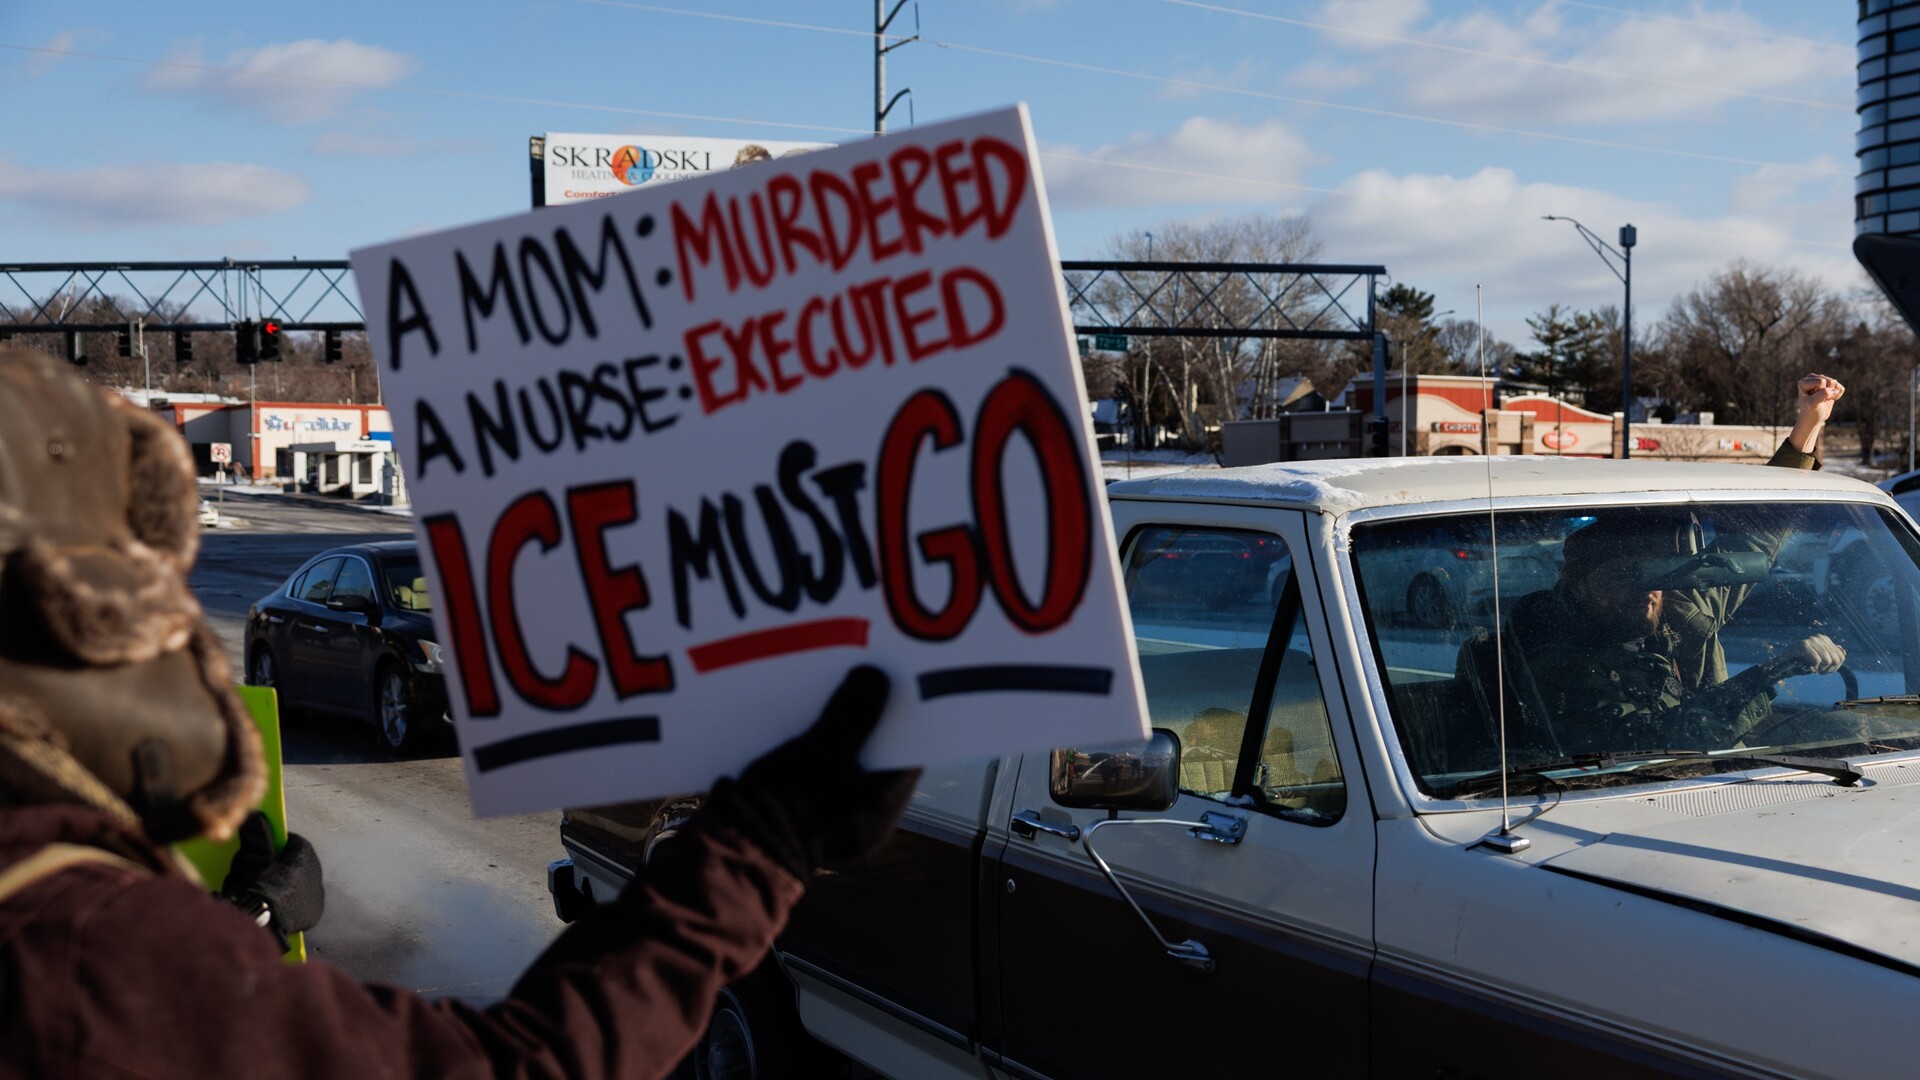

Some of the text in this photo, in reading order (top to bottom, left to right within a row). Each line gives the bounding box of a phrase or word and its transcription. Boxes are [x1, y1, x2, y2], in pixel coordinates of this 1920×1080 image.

[552, 145, 712, 171] SKRADSKI
[571, 169, 696, 181] HEATING & COOLING
[564, 190, 616, 199] Comfort
[386, 135, 1029, 372] A MOM: MURDERED
[415, 265, 1006, 481] A NURSE: EXECUTED
[283, 416, 353, 432] ucellular
[421, 366, 1095, 720] ICE MUST GO
